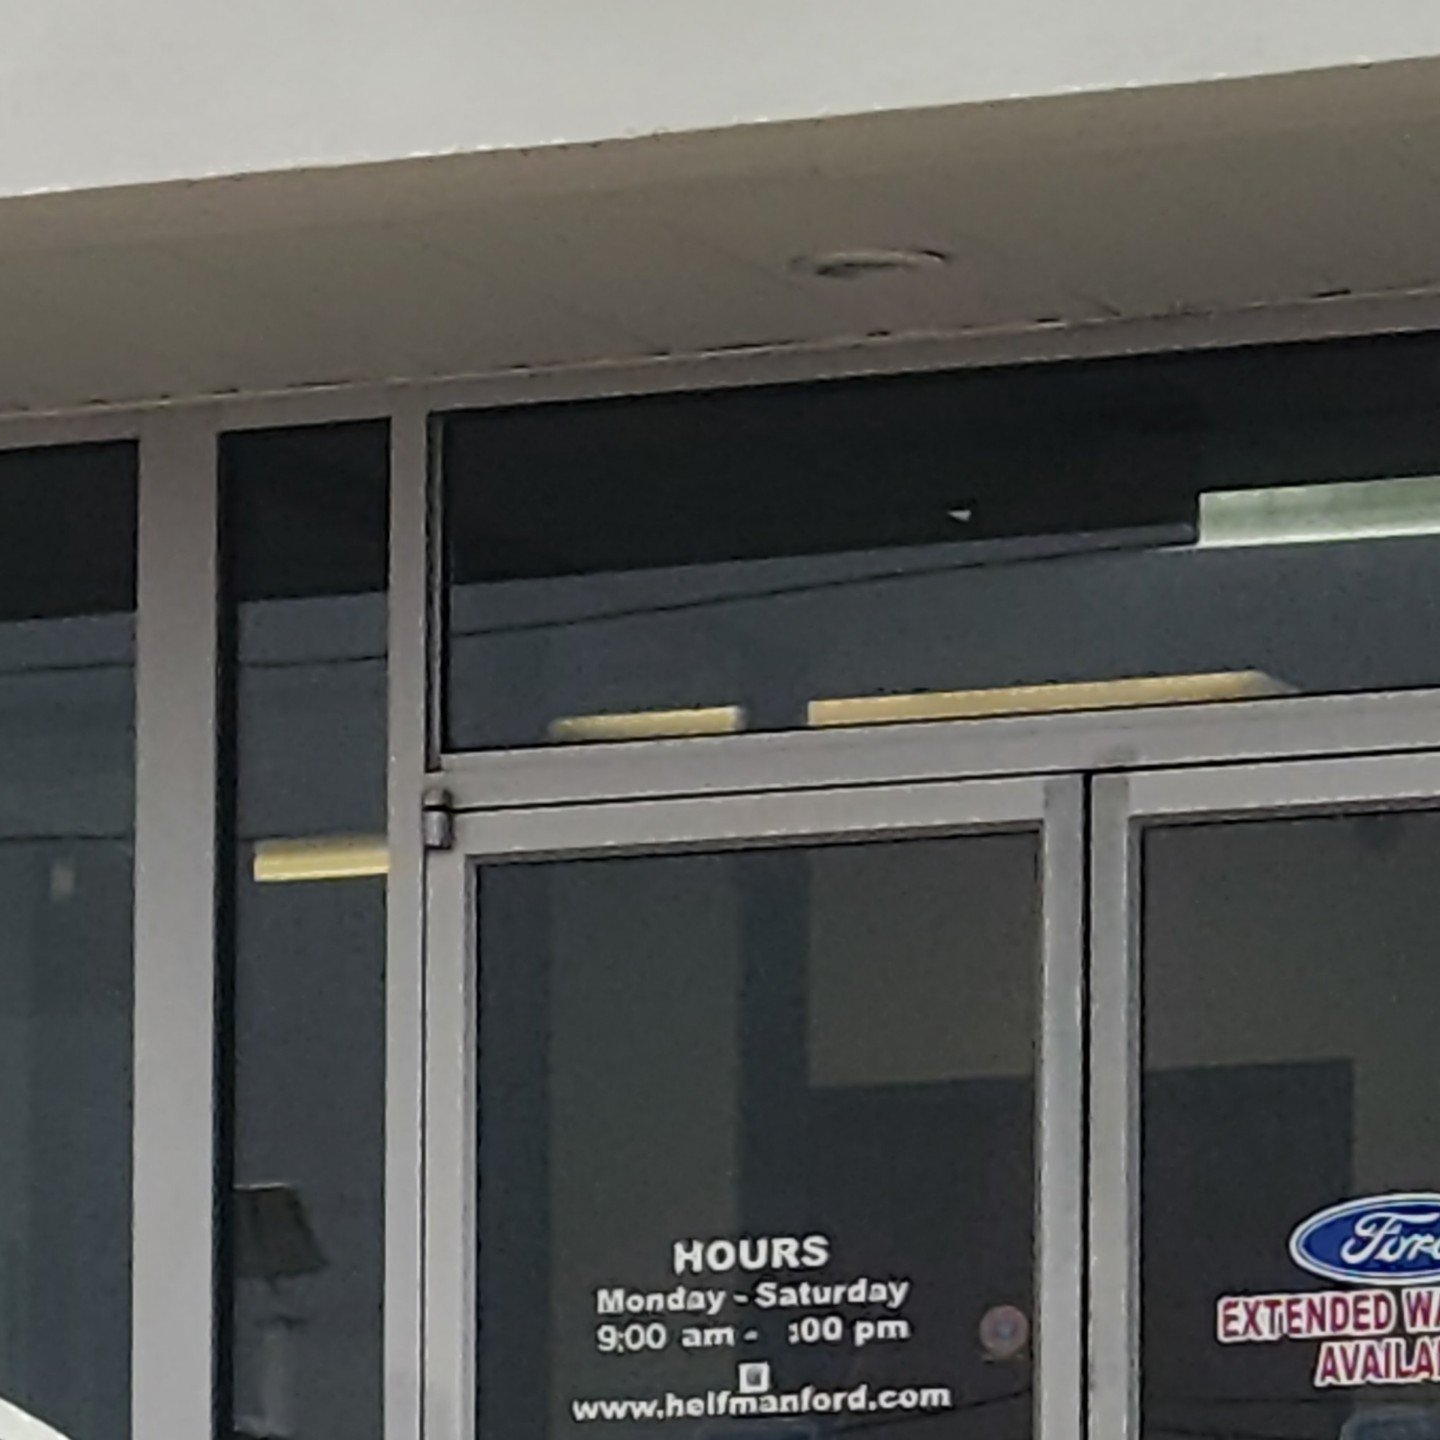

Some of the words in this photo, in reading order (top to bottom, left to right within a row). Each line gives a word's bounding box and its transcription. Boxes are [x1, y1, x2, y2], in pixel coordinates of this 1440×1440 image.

[672, 1235, 831, 1275] HOURS
[596, 1288, 727, 1316] Monday
[754, 1277, 911, 1310] Saturday
[596, 1321, 668, 1353] 9:00
[681, 1325, 735, 1347] am
[854, 1318, 910, 1347] pm
[1221, 1295, 1393, 1338] EXTENDED
[1320, 1341, 1440, 1382] AVAILA
[572, 1384, 953, 1421] www.helfmanford.com
